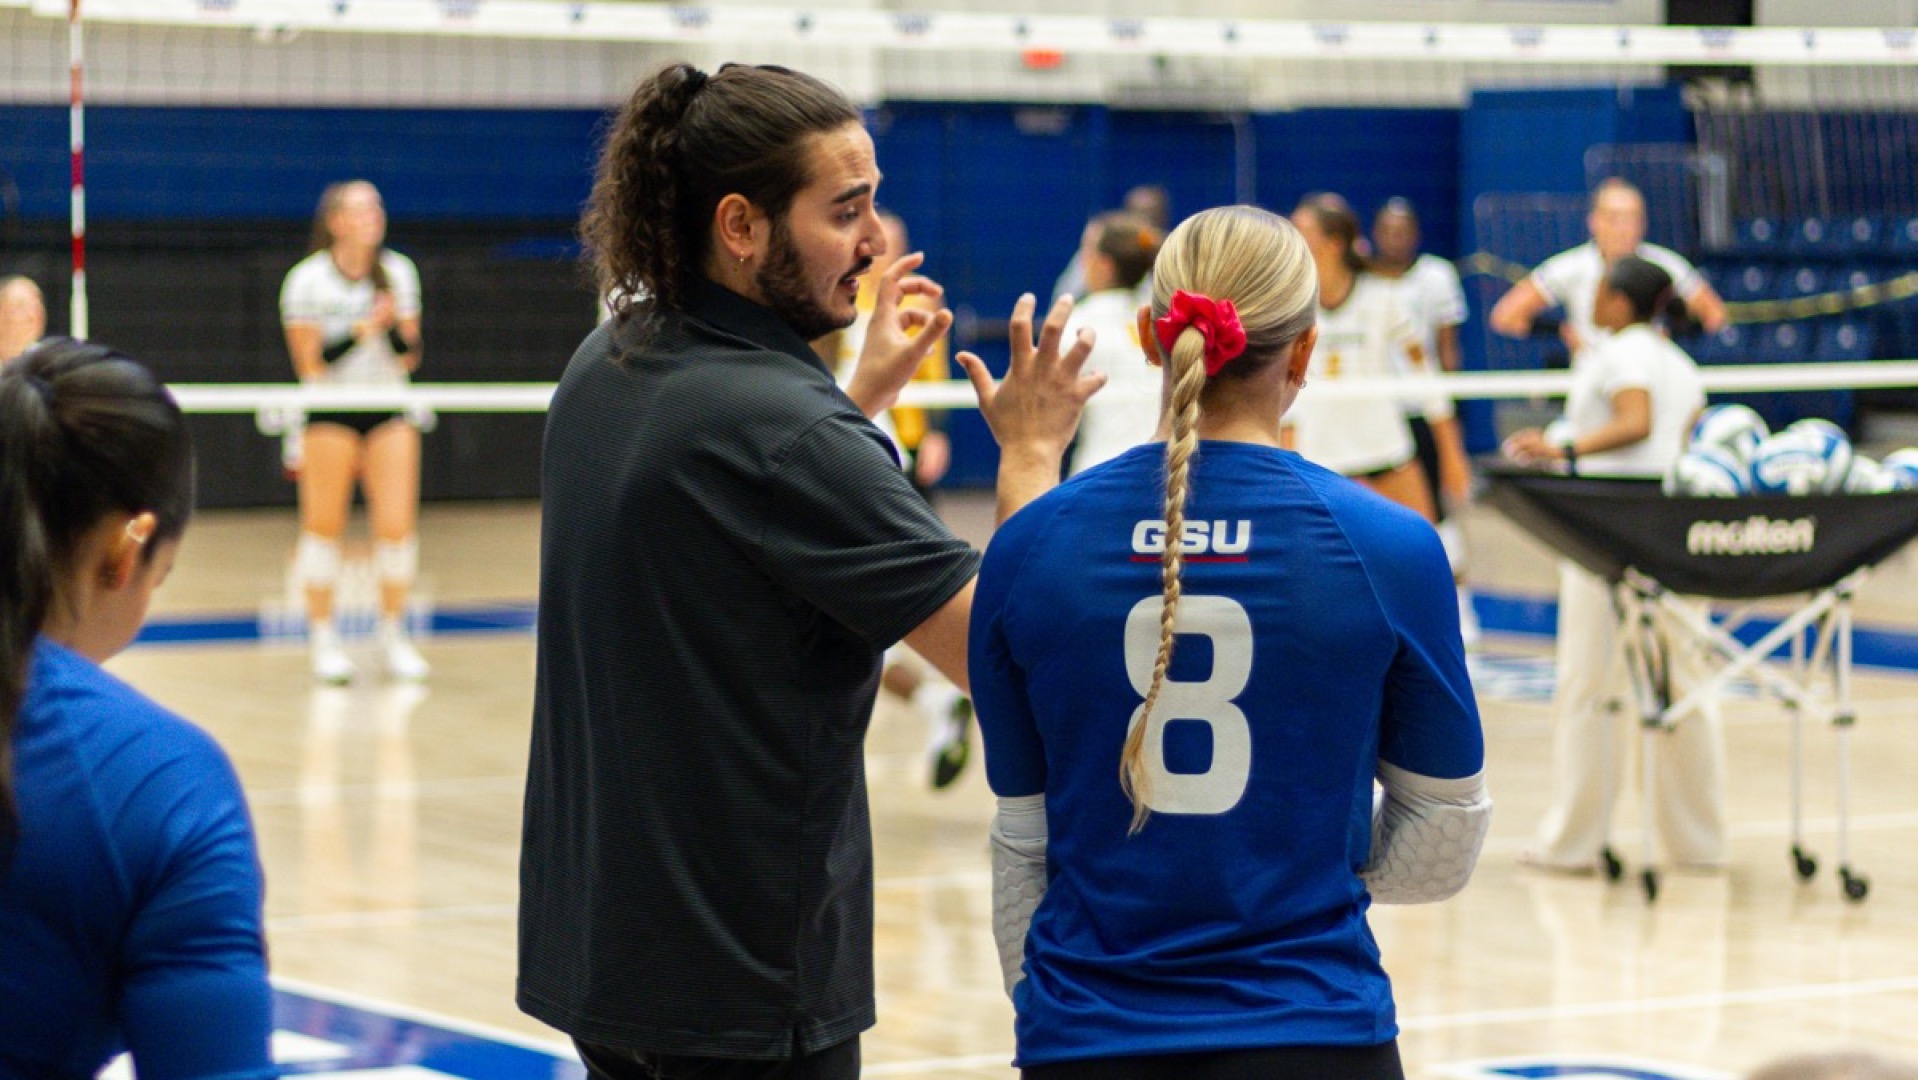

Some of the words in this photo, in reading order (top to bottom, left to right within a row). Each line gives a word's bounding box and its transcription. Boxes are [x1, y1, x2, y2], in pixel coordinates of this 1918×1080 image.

[1131, 519, 1252, 553] GSU
[1686, 515, 1815, 556] molten
[1124, 595, 1254, 815] 8
